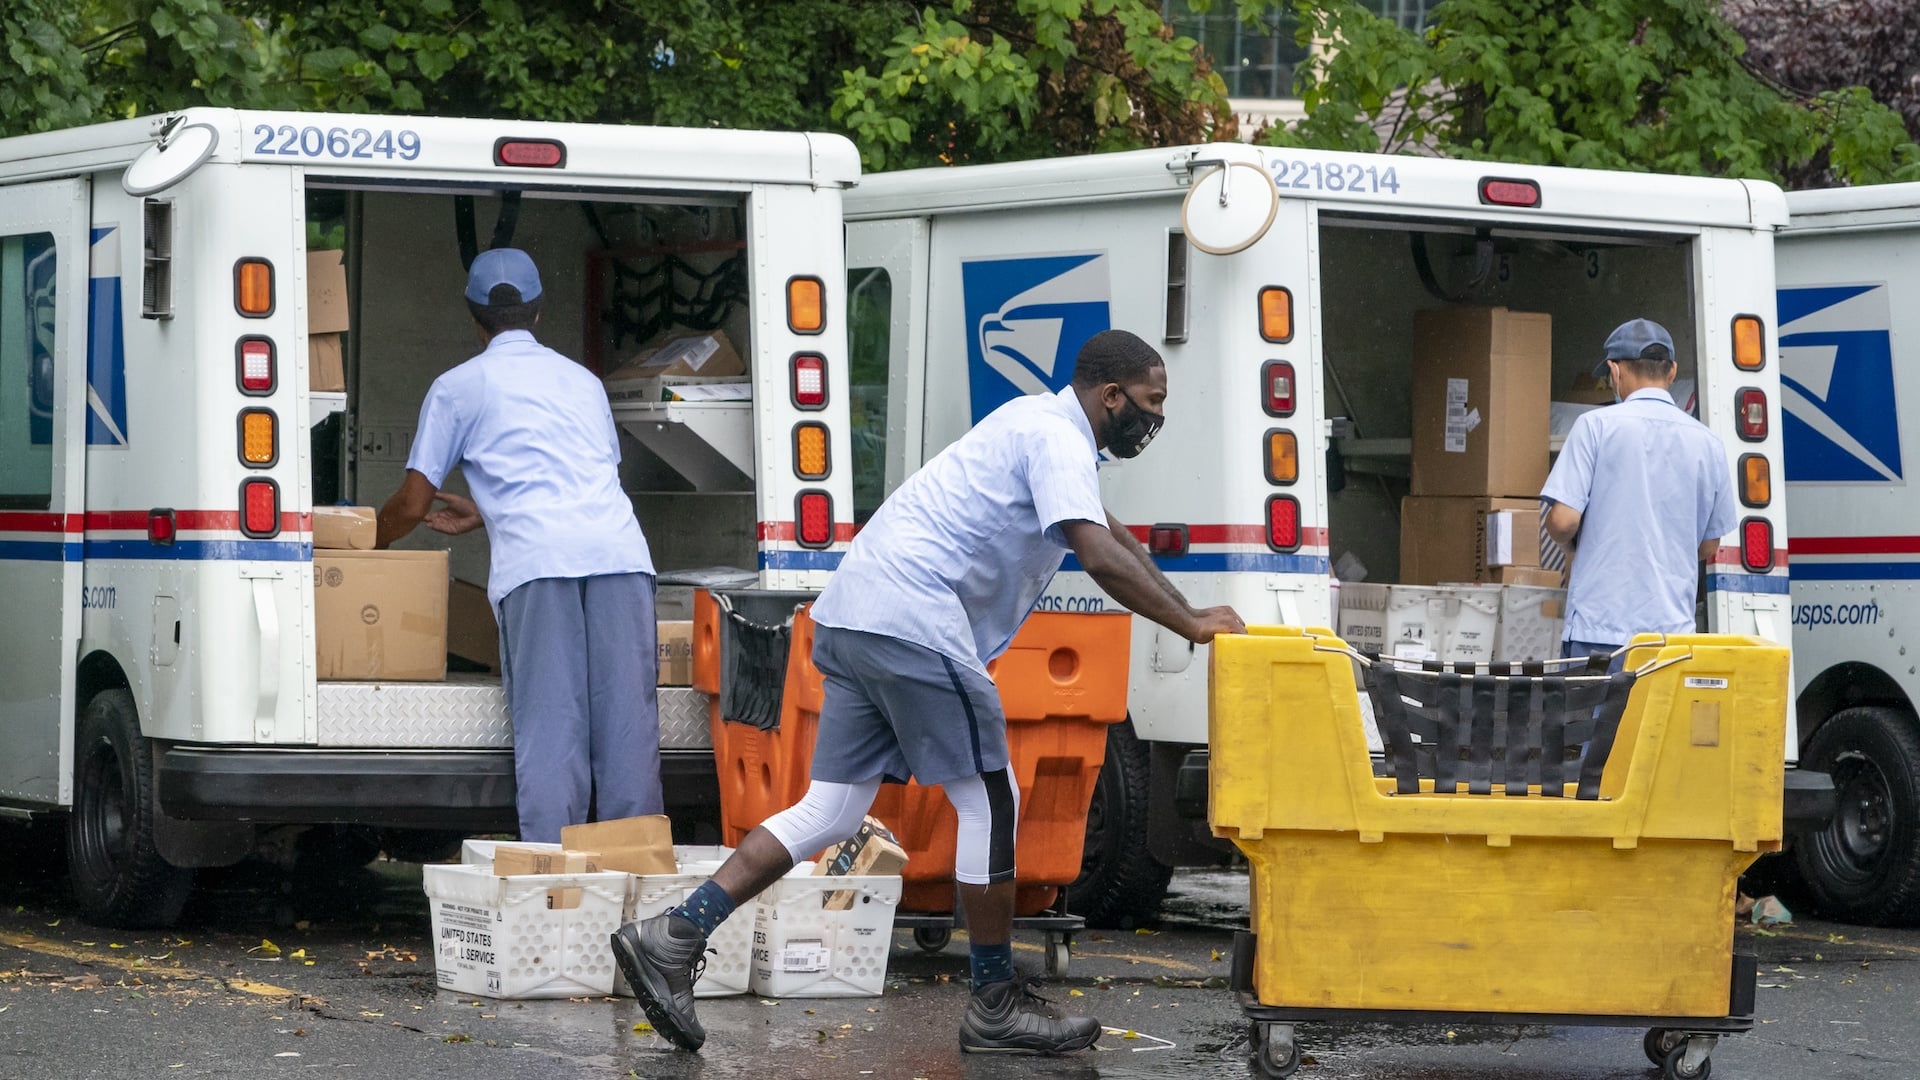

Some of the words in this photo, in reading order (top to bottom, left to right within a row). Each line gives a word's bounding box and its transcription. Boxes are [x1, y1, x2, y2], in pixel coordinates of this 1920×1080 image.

[254, 124, 421, 161] 2206249
[1270, 159, 1400, 194] 2218214
[1587, 251, 1598, 279] 3
[1792, 604, 1878, 631] usps.com
[442, 927, 465, 942] UNITED
[466, 931, 491, 947] STATES
[466, 948, 495, 965] SERVICE
